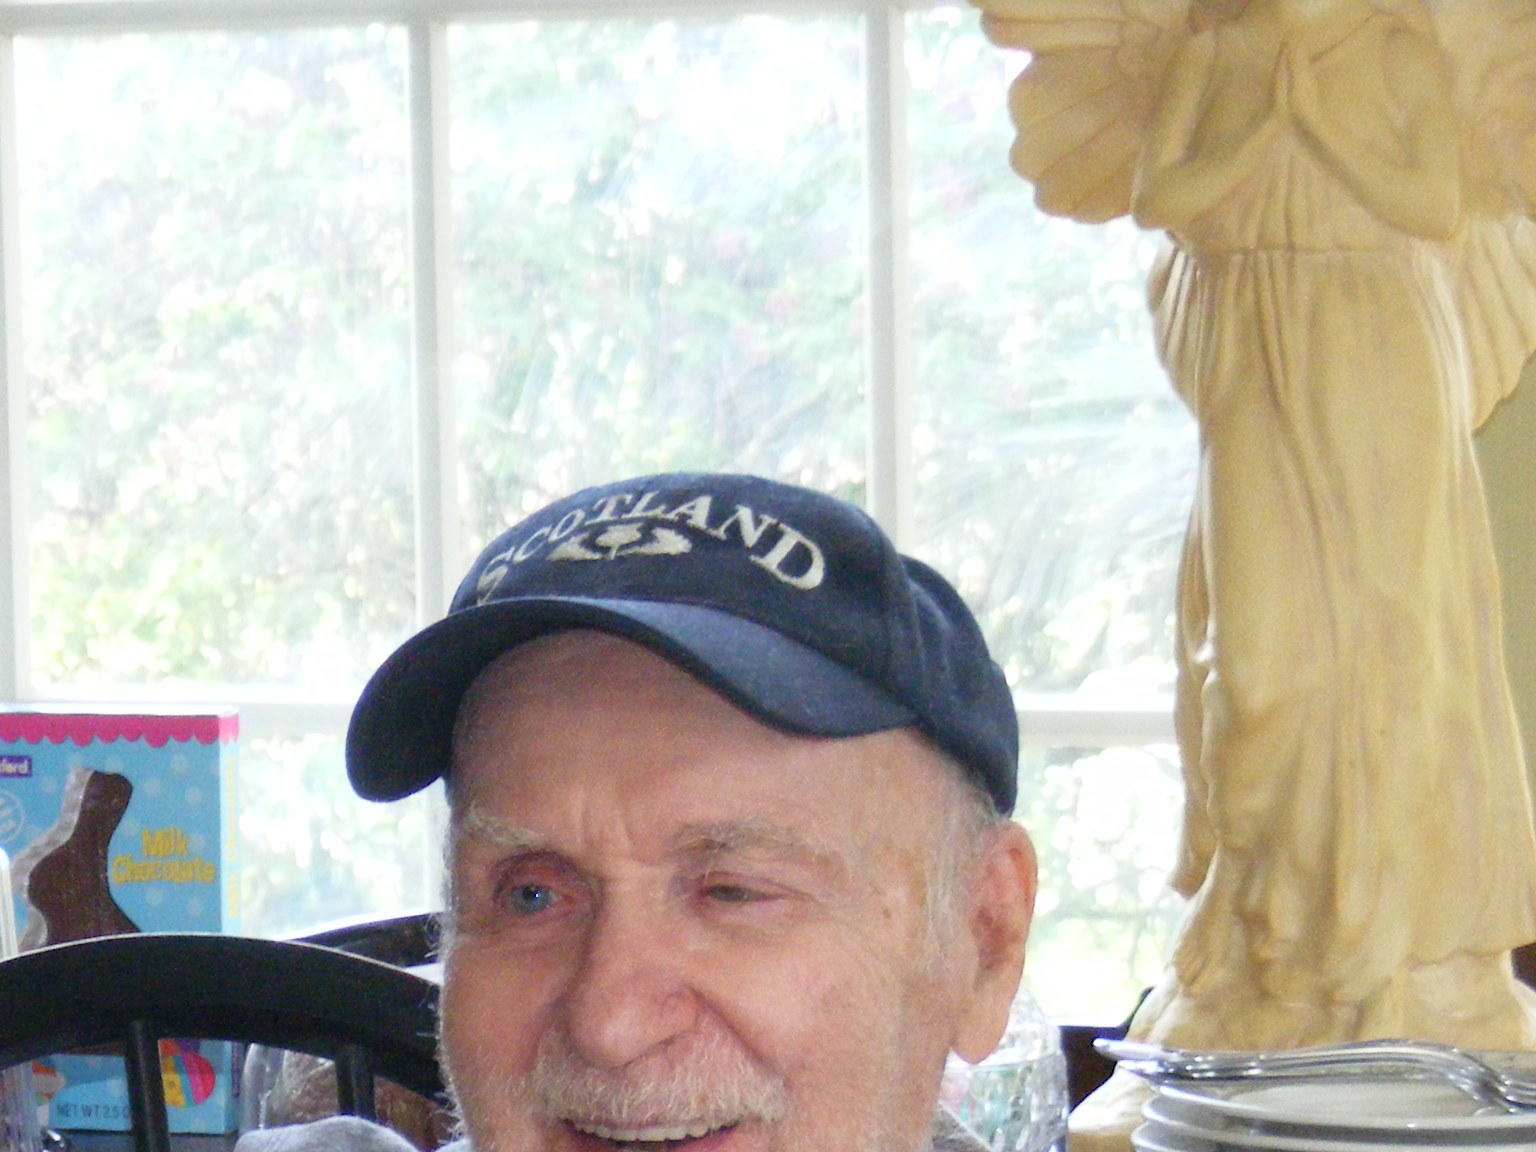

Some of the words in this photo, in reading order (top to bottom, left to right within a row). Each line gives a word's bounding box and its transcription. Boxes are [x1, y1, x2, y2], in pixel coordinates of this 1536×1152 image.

[477, 492, 825, 605] SCOTLAND
[142, 827, 188, 857] Milk
[113, 853, 216, 884] Chocolate
[57, 1103, 79, 1118] NET
